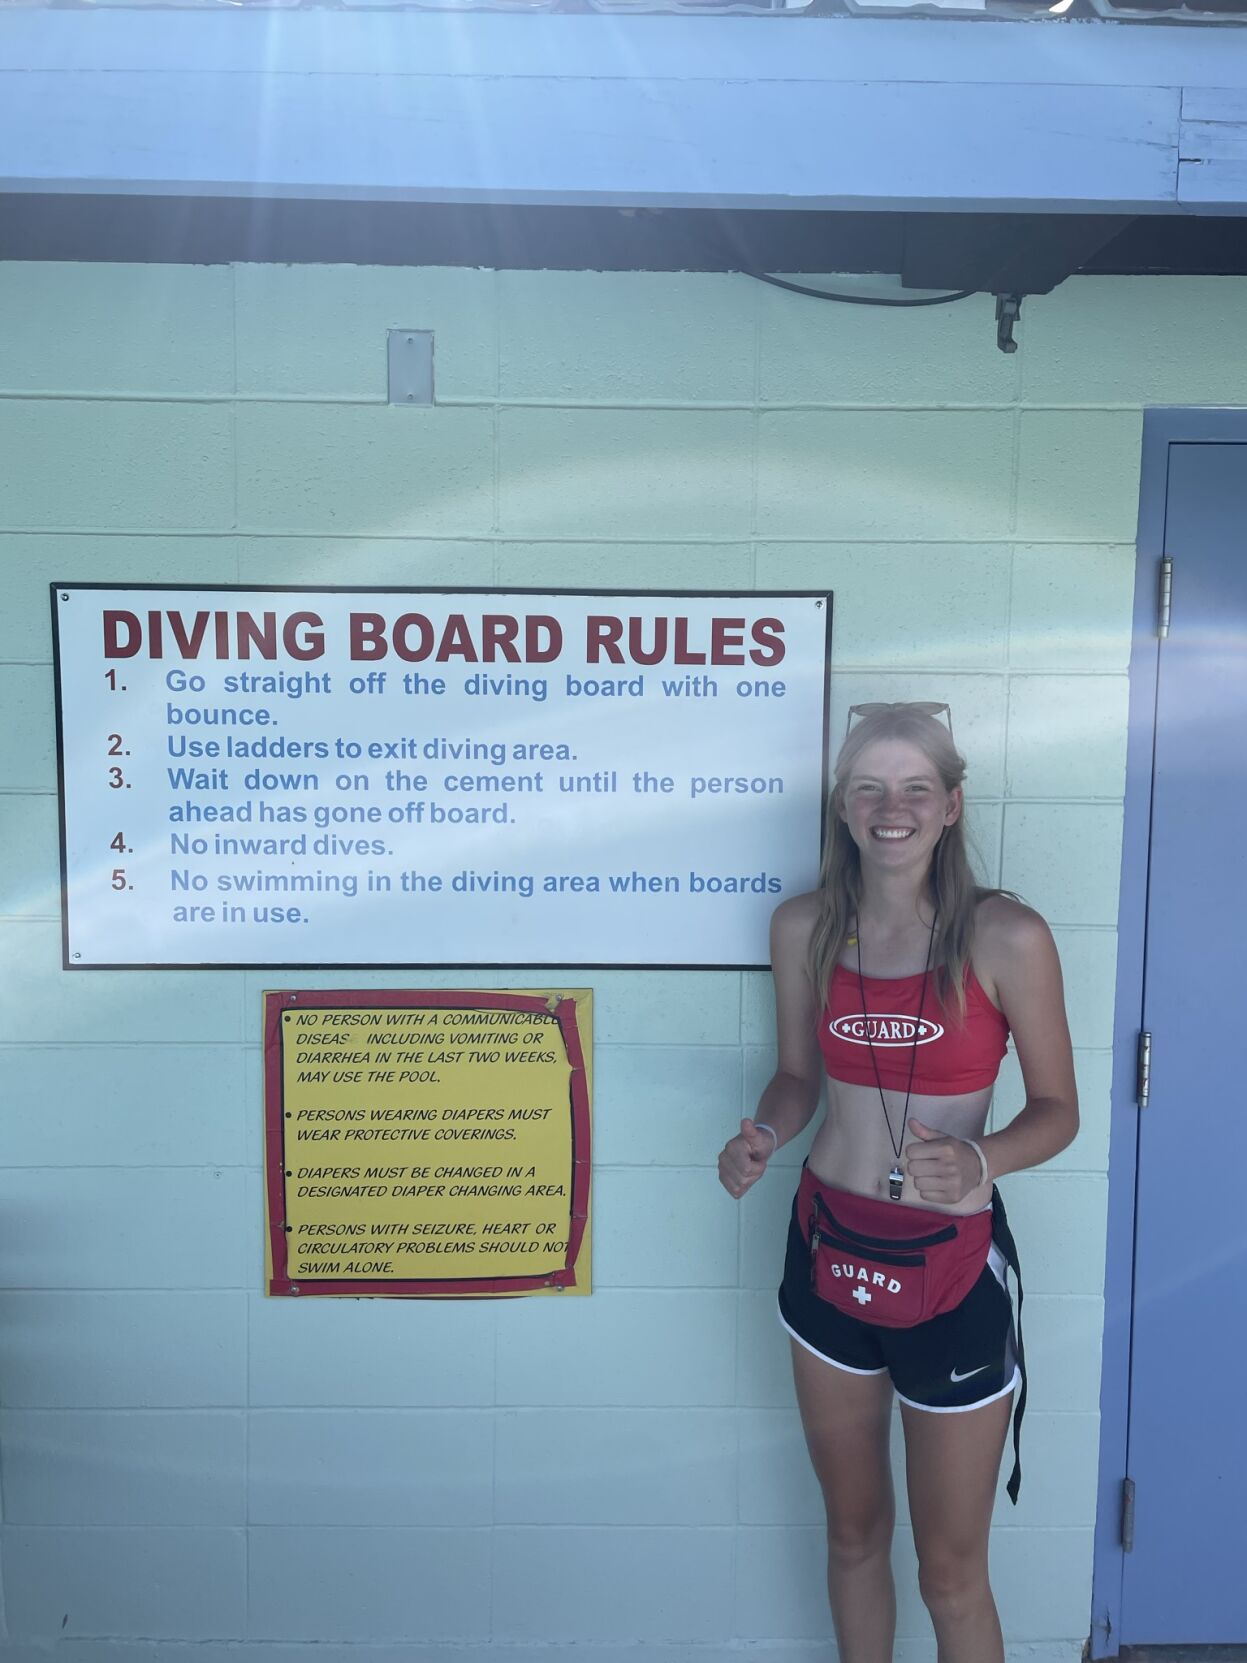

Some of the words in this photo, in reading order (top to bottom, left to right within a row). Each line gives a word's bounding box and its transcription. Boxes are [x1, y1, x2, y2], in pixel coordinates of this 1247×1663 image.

[103, 610, 325, 661] DIVING
[350, 612, 562, 664] BOARD
[586, 616, 786, 666] RULES
[105, 669, 126, 691] 1.
[166, 670, 205, 692] Go
[224, 671, 331, 698] straight
[350, 672, 386, 694] off
[403, 673, 445, 695] the
[464, 674, 548, 701] diving
[567, 675, 644, 697] board
[662, 676, 717, 697] with
[737, 681, 786, 697] one
[167, 703, 278, 725] bounce.
[108, 735, 131, 755] 2.
[168, 736, 220, 758] Use
[228, 737, 328, 758] ladders
[335, 739, 362, 758] to
[368, 738, 417, 759] exit
[423, 738, 506, 765] diving
[513, 743, 577, 760] area.
[109, 767, 132, 788] 3.
[168, 768, 228, 790] Wait
[244, 769, 318, 790] down
[336, 775, 369, 791] on
[386, 770, 428, 791] the
[444, 773, 543, 792] cement
[559, 772, 616, 792] until
[633, 773, 674, 793] the
[691, 777, 784, 798] person
[169, 801, 251, 822] ahead
[259, 802, 307, 822] has
[314, 808, 381, 828] gone
[388, 802, 424, 823] off
[431, 803, 516, 824] board.
[111, 832, 133, 853] 4.
[171, 833, 208, 854] No
[215, 834, 307, 855] inward
[313, 835, 393, 855] dives.
[112, 869, 133, 890] 5.
[171, 870, 208, 891] No
[218, 871, 358, 896] swimming
[368, 871, 391, 891] in
[400, 872, 442, 892] the
[452, 871, 534, 897] diving
[544, 877, 600, 892] area
[609, 872, 679, 893] when
[690, 872, 782, 893] boards
[173, 907, 215, 922] are
[223, 902, 245, 922] in
[253, 908, 309, 923] use.
[295, 1014, 318, 1026] NO
[321, 1014, 381, 1026] PERSON
[385, 1014, 423, 1025] WITH
[426, 1014, 438, 1025] A
[851, 1020, 916, 1040] GUARD
[366, 1033, 445, 1044] INCLUDING
[449, 1033, 519, 1044] VOMITING
[522, 1033, 543, 1044] OR
[296, 1052, 369, 1064] DIARRHEA
[374, 1052, 392, 1063] IN
[395, 1052, 423, 1063] THE
[426, 1052, 462, 1063] LAST
[467, 1052, 500, 1063] TWO
[503, 1052, 557, 1064] WEEKS,
[296, 1072, 331, 1083] MAY
[333, 1072, 363, 1083] USE
[366, 1072, 395, 1082] THE
[398, 1071, 441, 1082] POOL.
[296, 1109, 366, 1121] PERSONS
[369, 1109, 438, 1121] WEARING
[441, 1109, 504, 1120] DIAPERS
[507, 1109, 552, 1120] MUST
[296, 1130, 339, 1141] WEAR
[343, 1129, 429, 1141] PROTECTIVE
[433, 1129, 517, 1140] COVERINGS.
[297, 1168, 361, 1179] DIAPERS
[363, 1167, 407, 1178] MUST
[410, 1167, 430, 1178] BE
[433, 1167, 503, 1178] CHANGED
[505, 1167, 522, 1178] IN
[524, 1167, 536, 1177] A
[297, 1186, 387, 1198] DESIGNATED
[391, 1186, 445, 1197] DIAPER
[448, 1185, 521, 1197] CHANGING
[524, 1185, 566, 1197] AREA.
[297, 1224, 366, 1236] PERSONS
[369, 1224, 408, 1235] WITH
[411, 1224, 476, 1236] SEIZURE,
[481, 1223, 530, 1235] HEART
[535, 1223, 556, 1234] OR
[297, 1242, 393, 1254] CIRCULATORY
[395, 1242, 475, 1253] PROBLEMS
[478, 1242, 539, 1253] SHOULD
[297, 1262, 340, 1274] SWIM
[342, 1262, 394, 1273] ALONE.
[831, 1263, 902, 1294] GUARD
